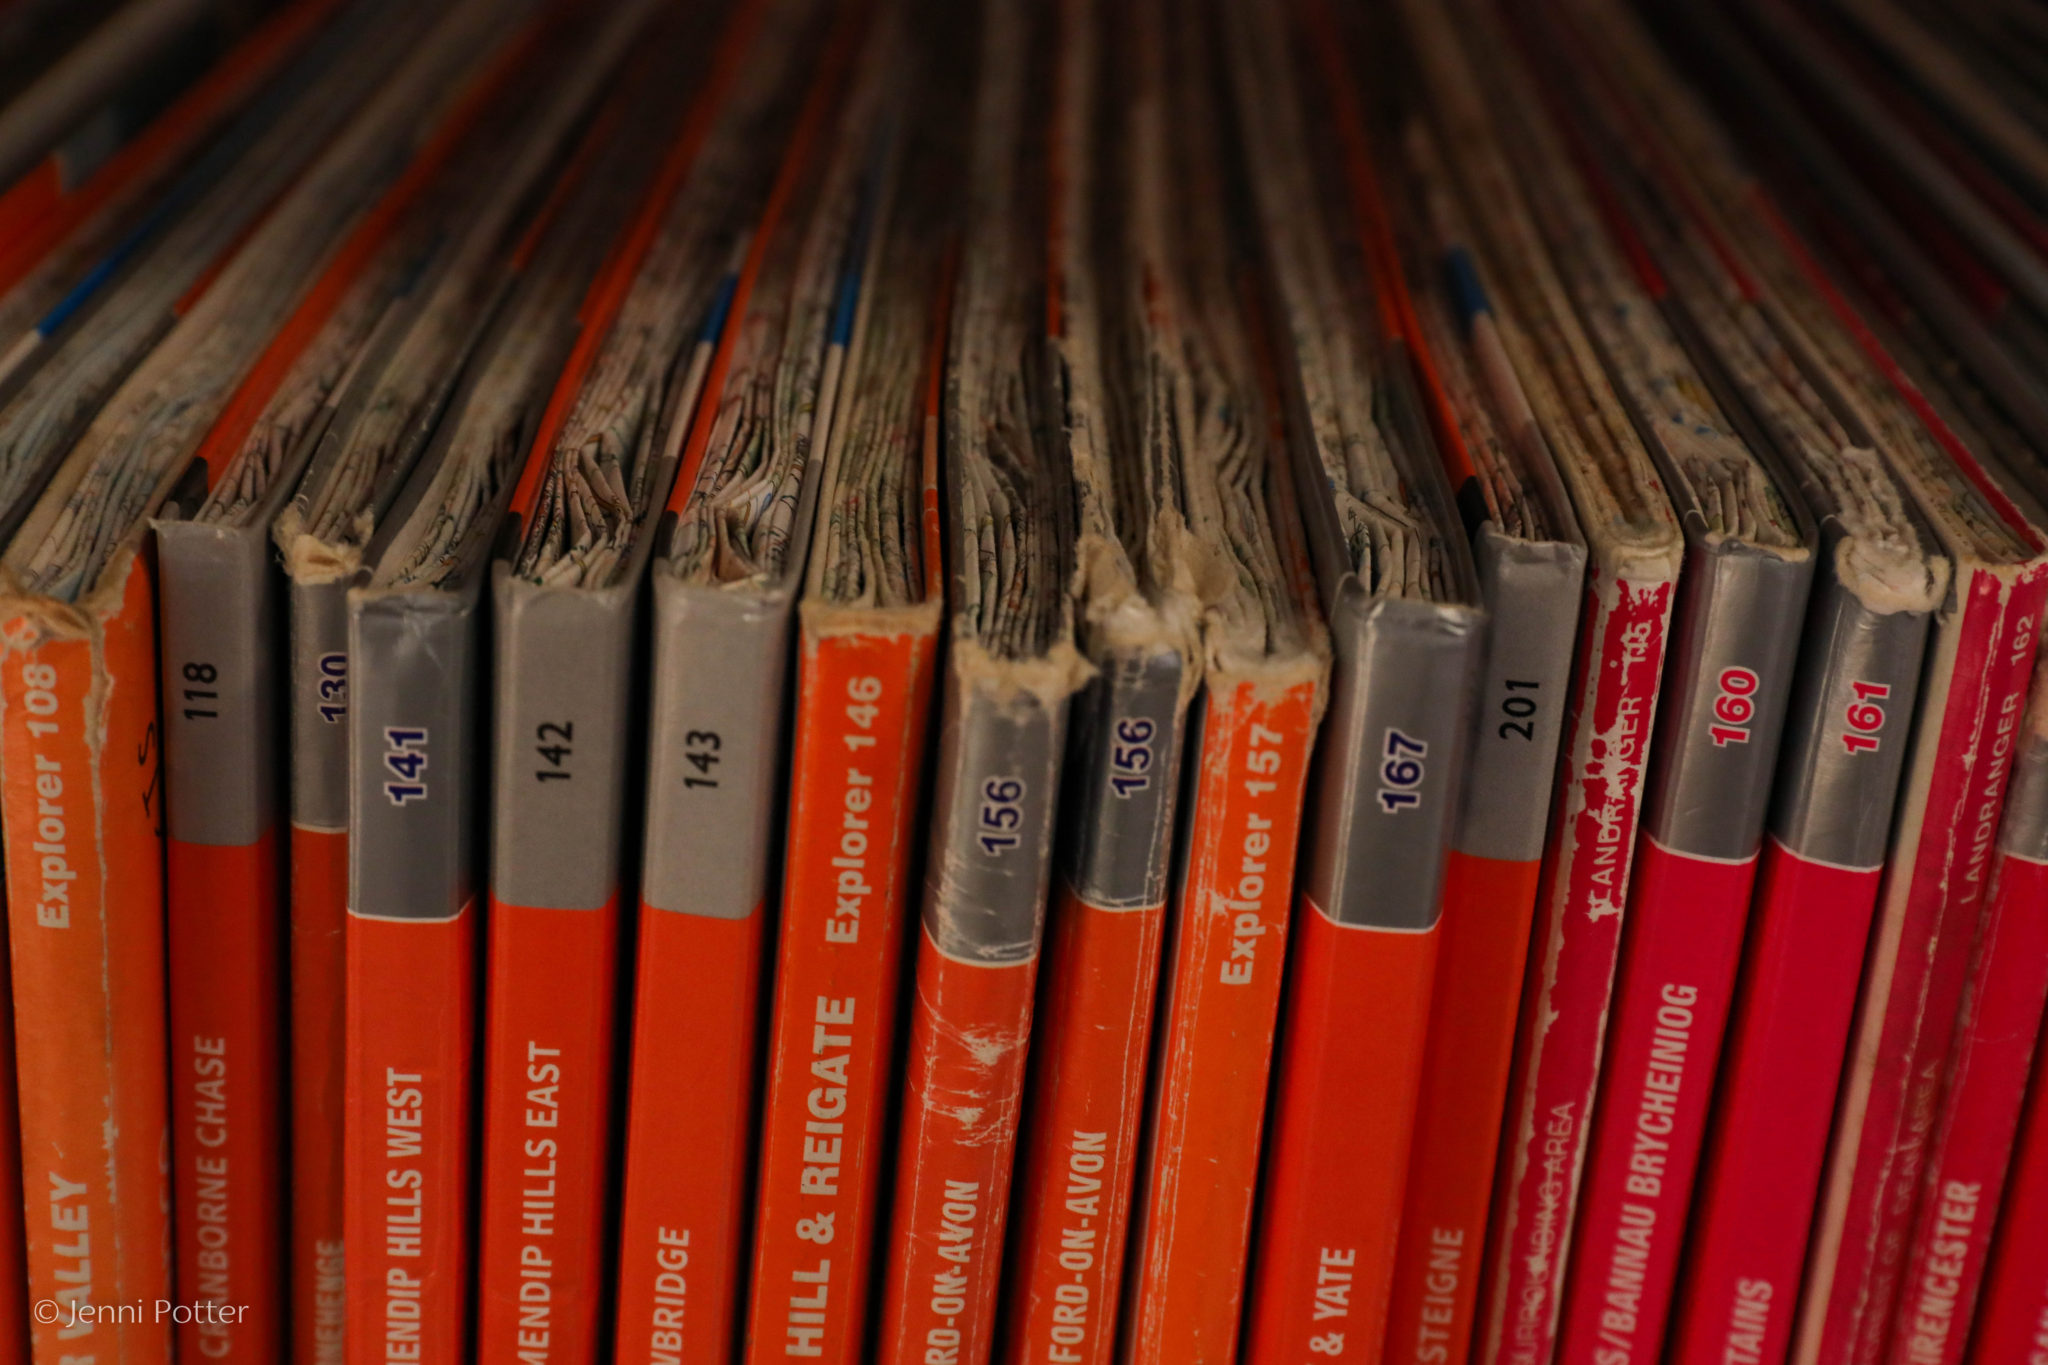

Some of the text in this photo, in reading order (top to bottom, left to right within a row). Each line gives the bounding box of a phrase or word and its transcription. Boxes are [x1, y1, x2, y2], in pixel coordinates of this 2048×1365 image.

[183, 662, 218, 720] 118
[318, 651, 347, 723] 130
[1499, 679, 1539, 741] 201
[1709, 665, 1760, 747] 160
[1842, 681, 1890, 755] 161
[384, 725, 427, 805] 141
[536, 720, 573, 783] 142
[684, 729, 721, 788] 143
[1111, 717, 1154, 798] 156
[1380, 728, 1428, 814] 167
[1961, 612, 2035, 904] LANDRANGER 162
[22, 663, 77, 929] Explorer 108
[825, 676, 882, 943] Explorer 146
[977, 776, 1024, 856] 156
[1220, 724, 1284, 985] Explorer 157
[526, 1041, 561, 1127] EAST
[1626, 983, 1698, 1198] BRYCHEINIOG
[786, 996, 855, 1357] HILL & REIGATE
[1542, 1101, 1576, 1174] AREA
[195, 1037, 232, 1358] CRANBORNE CHASE
[386, 1068, 422, 1365] ENDIP HILLS WEST
[523, 1138, 557, 1235] HILLS
[49, 1171, 94, 1340] VALLEY
[1048, 1130, 1107, 1363] FORD-ON-AVON
[315, 1240, 344, 1365] NEHENGE
[1309, 1247, 1356, 1356] & YATE
[1723, 1277, 1773, 1365] TAINS
